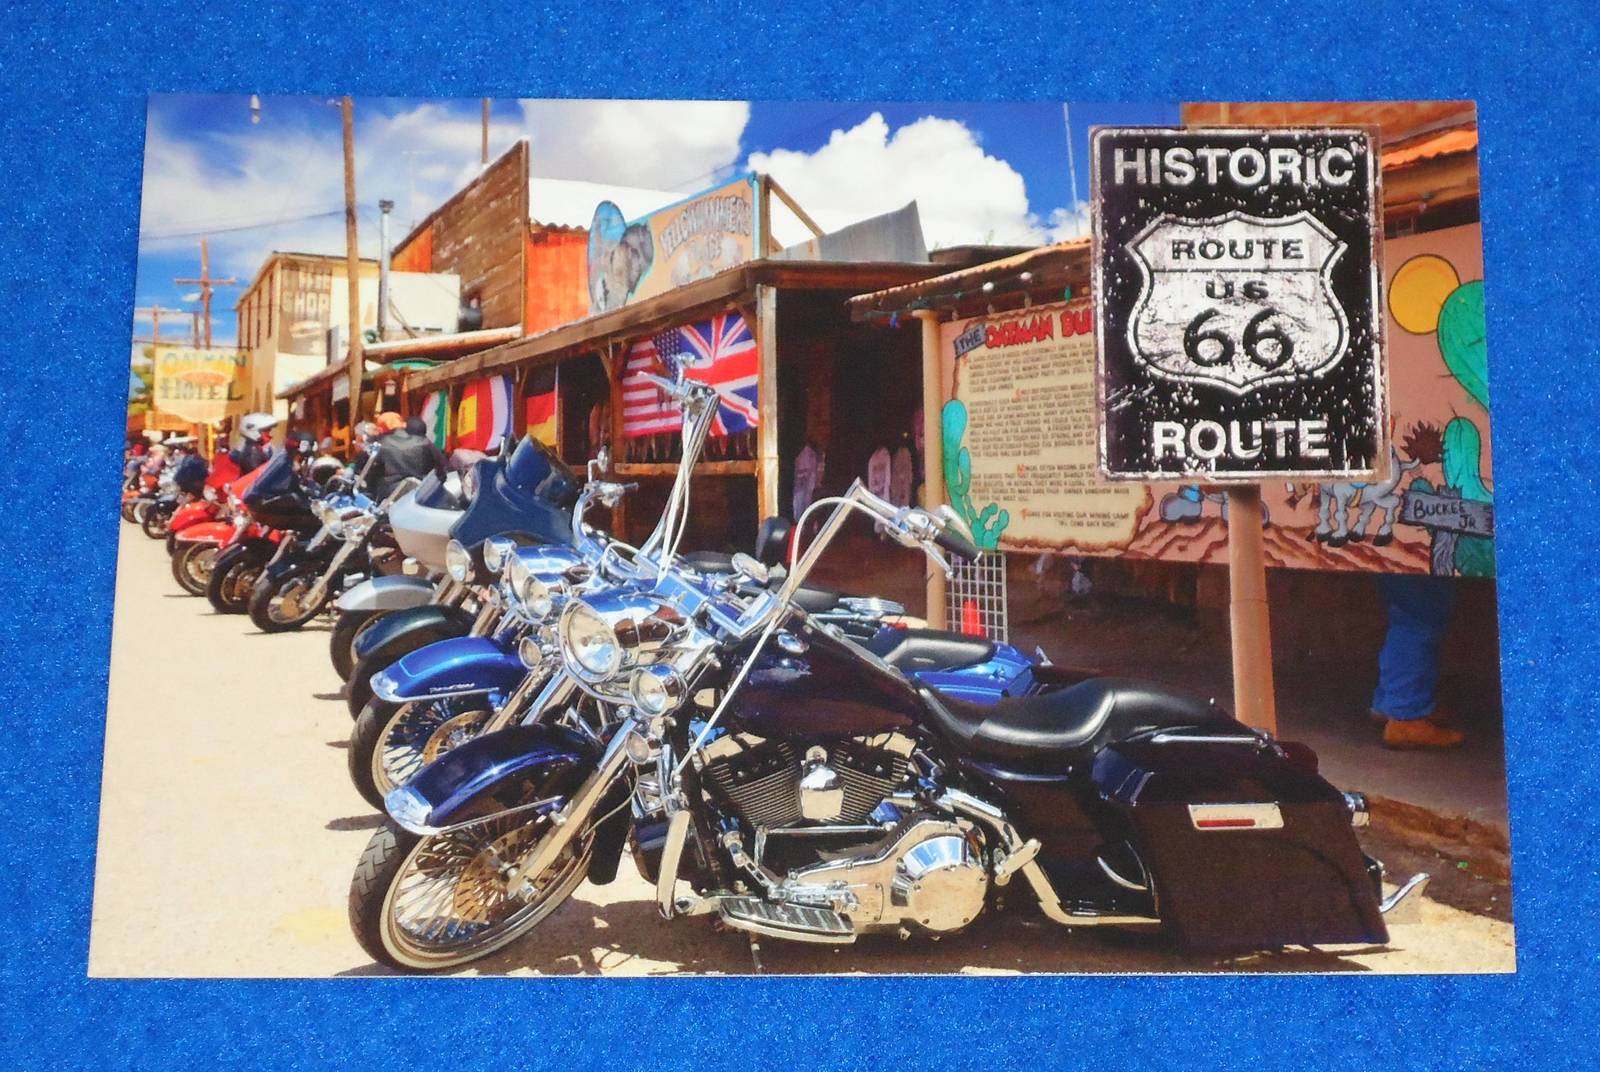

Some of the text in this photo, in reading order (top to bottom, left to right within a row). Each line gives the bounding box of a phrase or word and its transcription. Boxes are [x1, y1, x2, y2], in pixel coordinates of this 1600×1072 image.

[1113, 146, 1354, 186] HISTORIC
[1171, 238, 1305, 260] ROUTE
[1205, 280, 1270, 300] US
[959, 328, 981, 350] THE
[1183, 307, 1295, 369] 66
[159, 376, 244, 401] HOTEL
[1152, 420, 1330, 459] ROUTE
